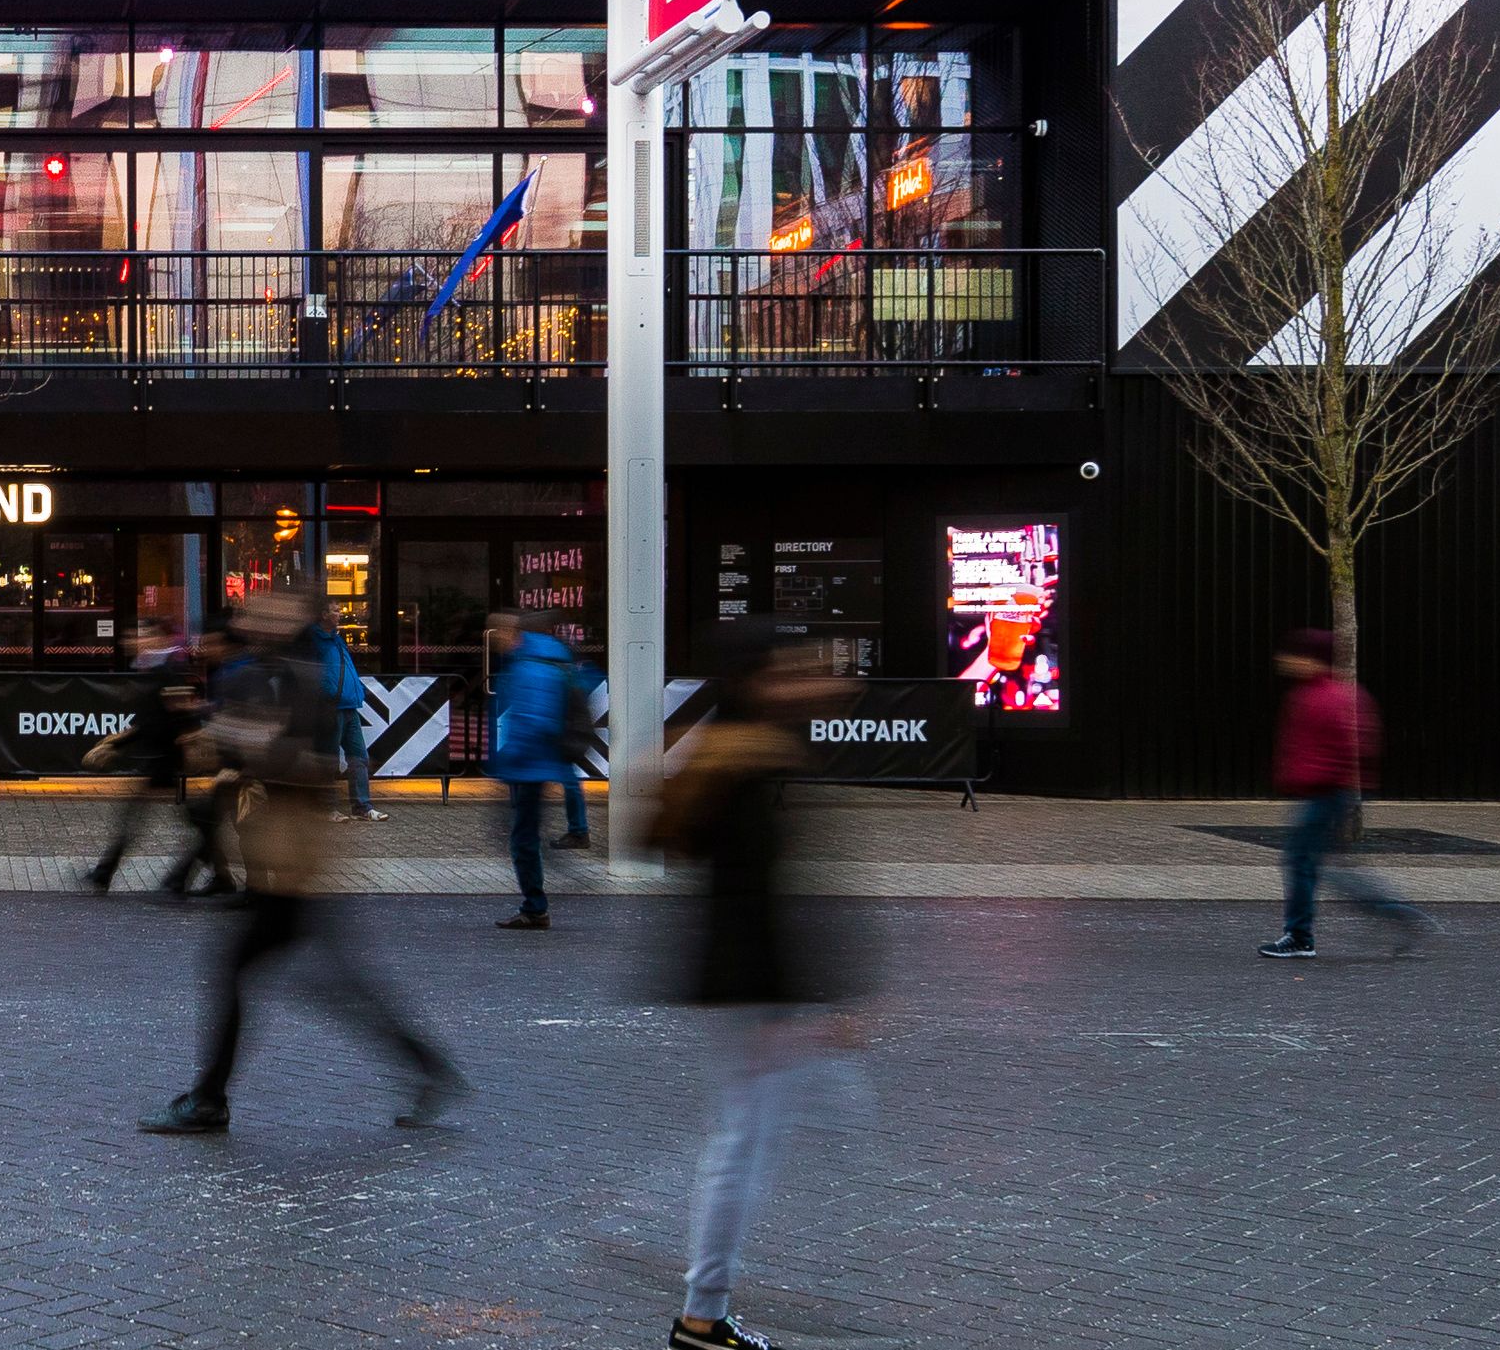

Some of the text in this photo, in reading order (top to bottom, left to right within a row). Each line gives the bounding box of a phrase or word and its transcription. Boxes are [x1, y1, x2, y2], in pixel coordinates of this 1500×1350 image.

[774, 542, 833, 552] DIRECTORY
[774, 565, 797, 573] FIRST
[775, 626, 808, 634] GROUND
[18, 712, 136, 735] BOXPARK
[810, 719, 927, 744] BOXPARK
